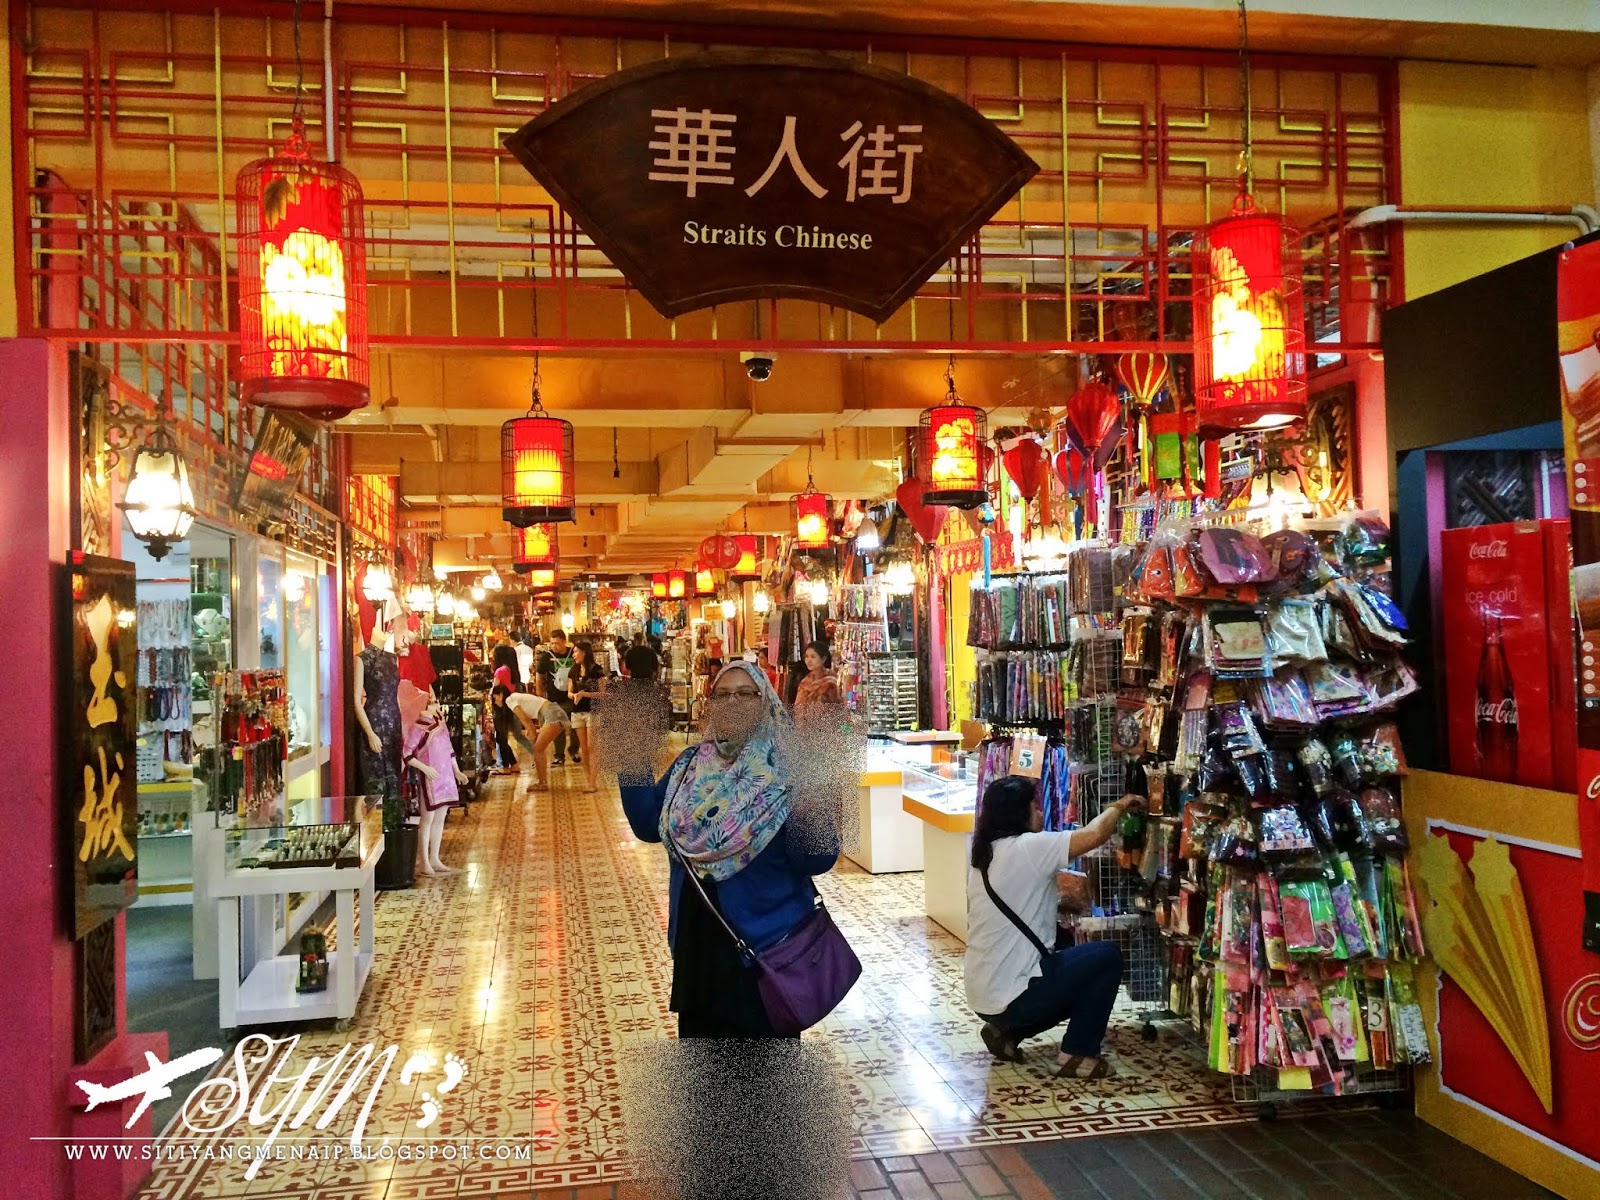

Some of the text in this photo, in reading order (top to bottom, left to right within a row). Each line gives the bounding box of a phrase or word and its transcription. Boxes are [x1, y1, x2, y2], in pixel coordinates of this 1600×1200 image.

[648, 107, 923, 204] 華人街
[683, 220, 873, 251] Straits Chinese
[1465, 587, 1518, 604] ice cold
[1369, 1001, 1382, 1027] 3
